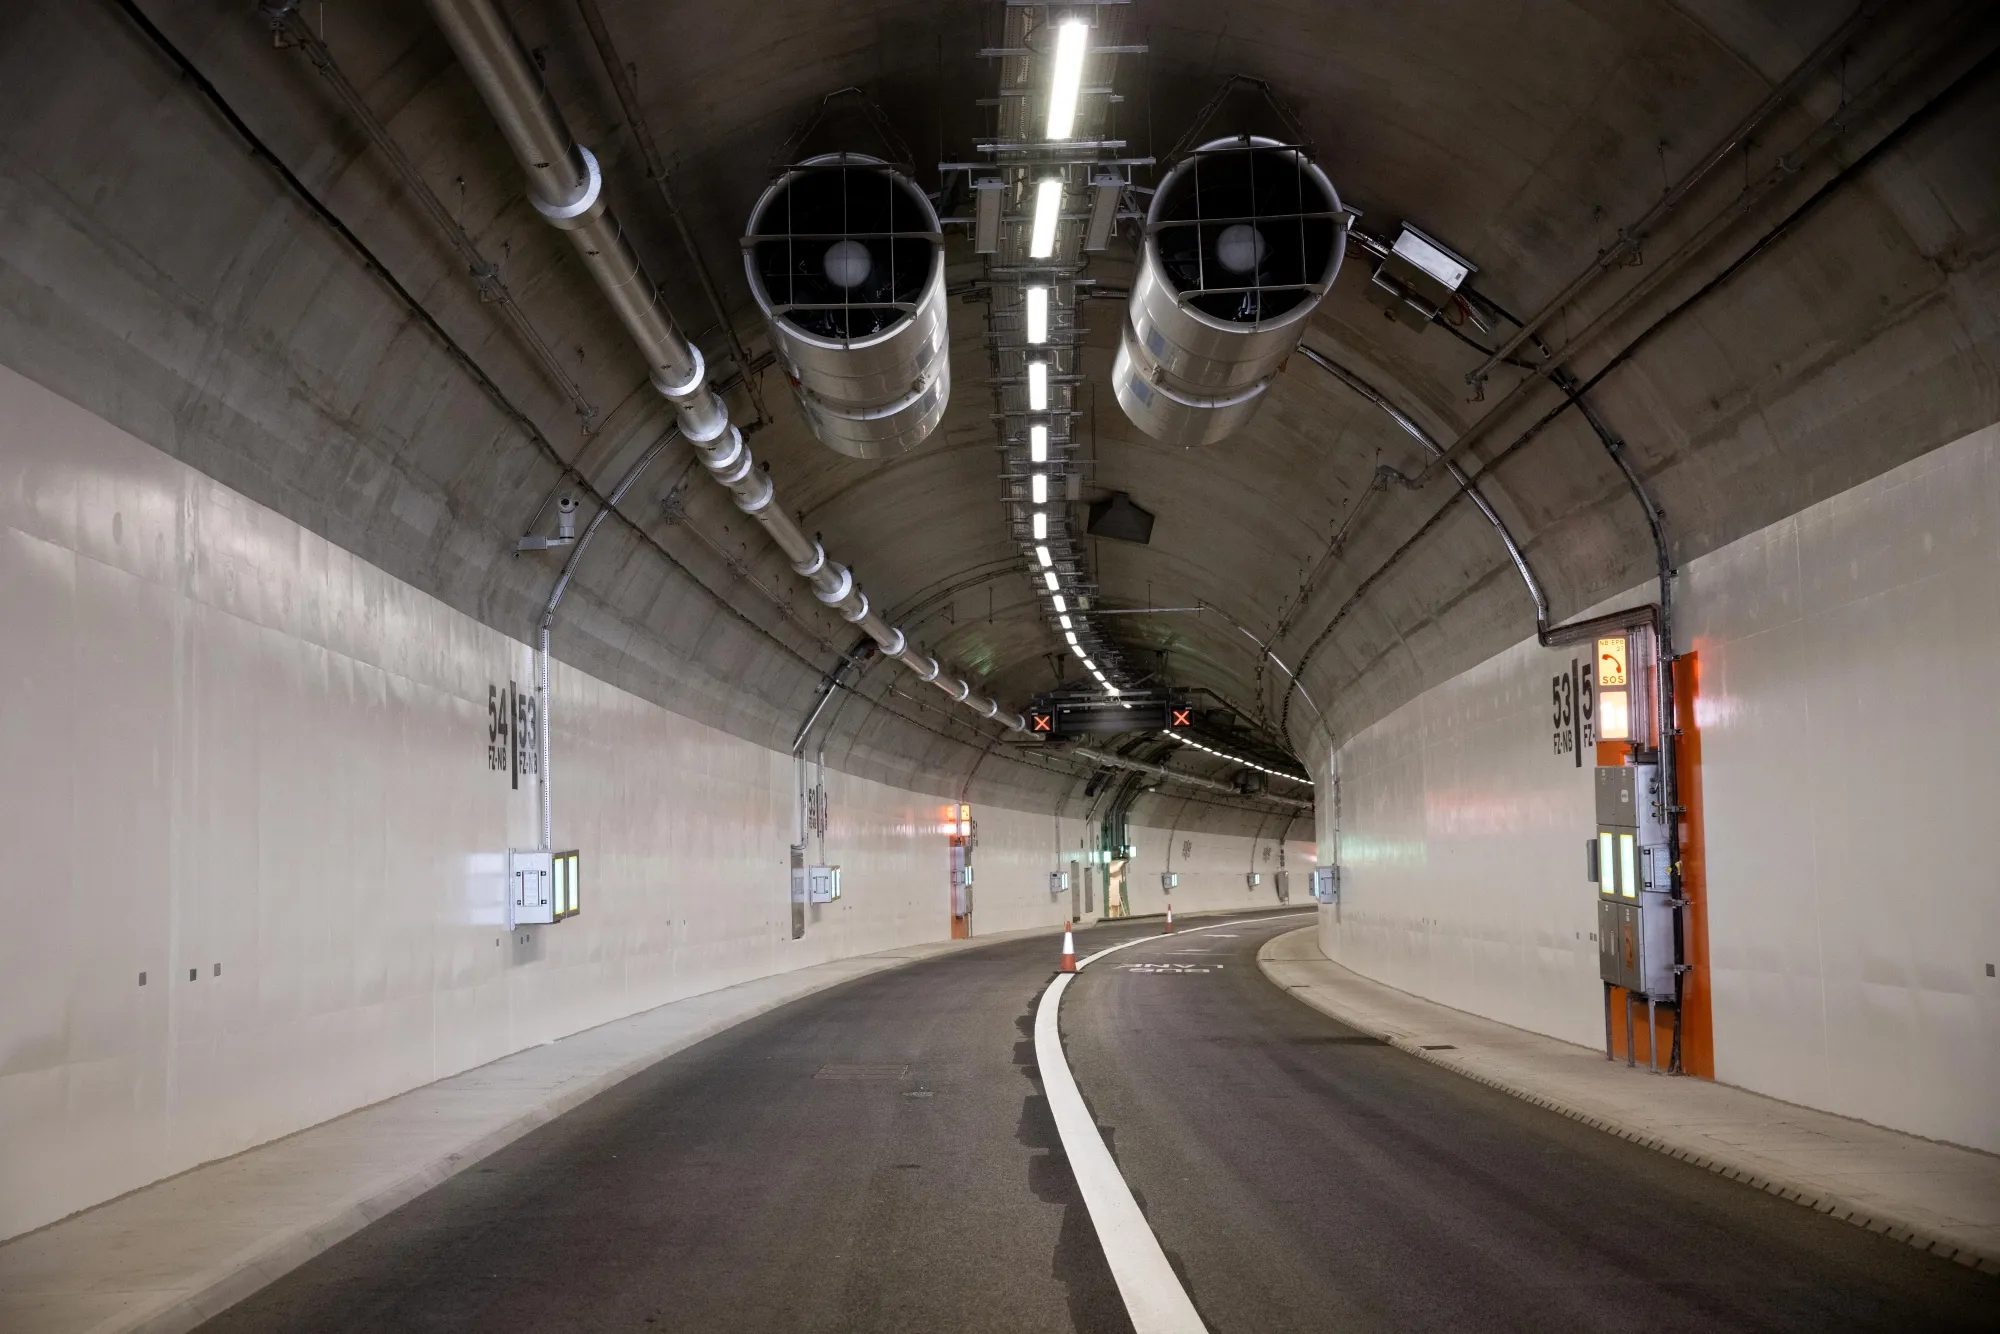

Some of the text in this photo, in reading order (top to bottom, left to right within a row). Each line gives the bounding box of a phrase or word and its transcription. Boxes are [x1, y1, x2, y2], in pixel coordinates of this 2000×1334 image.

[1582, 663, 1593, 721] 5
[1602, 675, 1624, 684] SOS
[1552, 672, 1571, 730] 53
[488, 684, 508, 746] 54
[518, 693, 537, 750] 53
[1553, 730, 1573, 755] FZ-NB
[1583, 723, 1596, 748] FZ-
[488, 745, 507, 771] FZ-NB
[518, 751, 538, 775] FZ-NB
